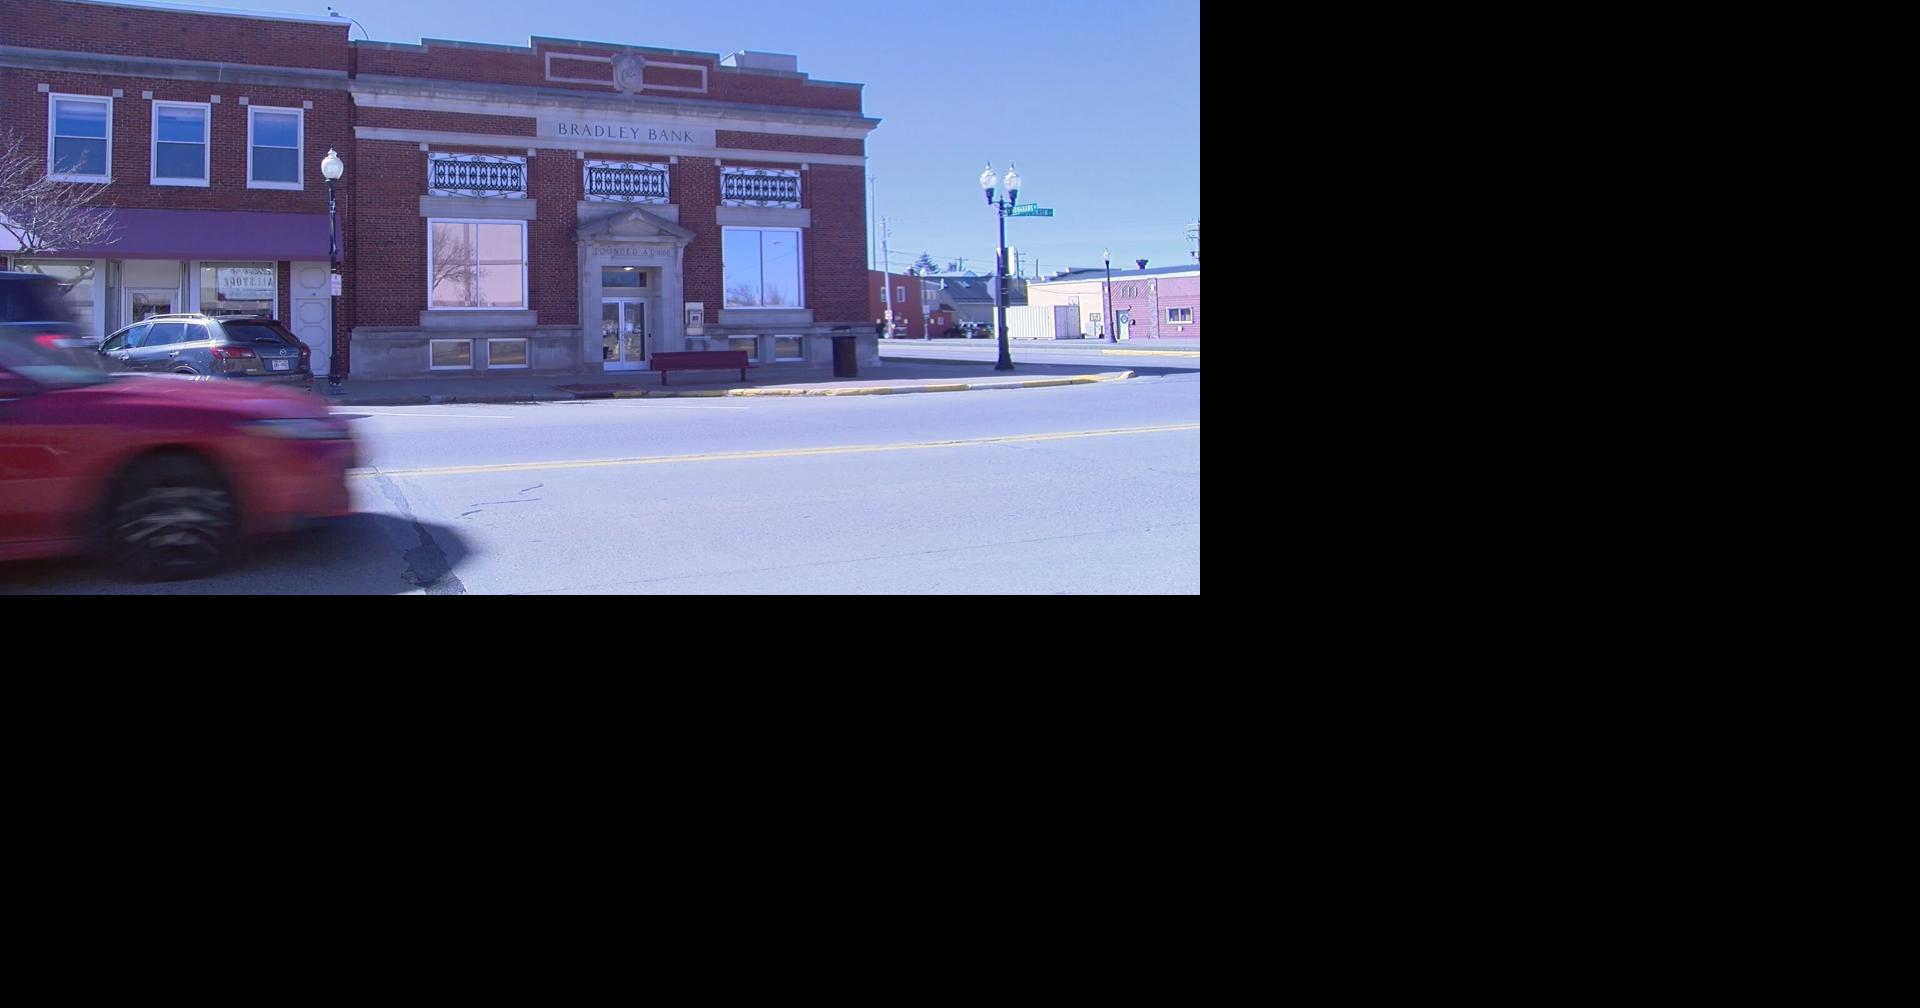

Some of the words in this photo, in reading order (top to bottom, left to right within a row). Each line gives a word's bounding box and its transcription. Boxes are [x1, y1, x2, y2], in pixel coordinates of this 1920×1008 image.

[558, 123, 640, 140] BRADLEY
[648, 128, 694, 142] BANK
[594, 247, 638, 256] FOUNDED
